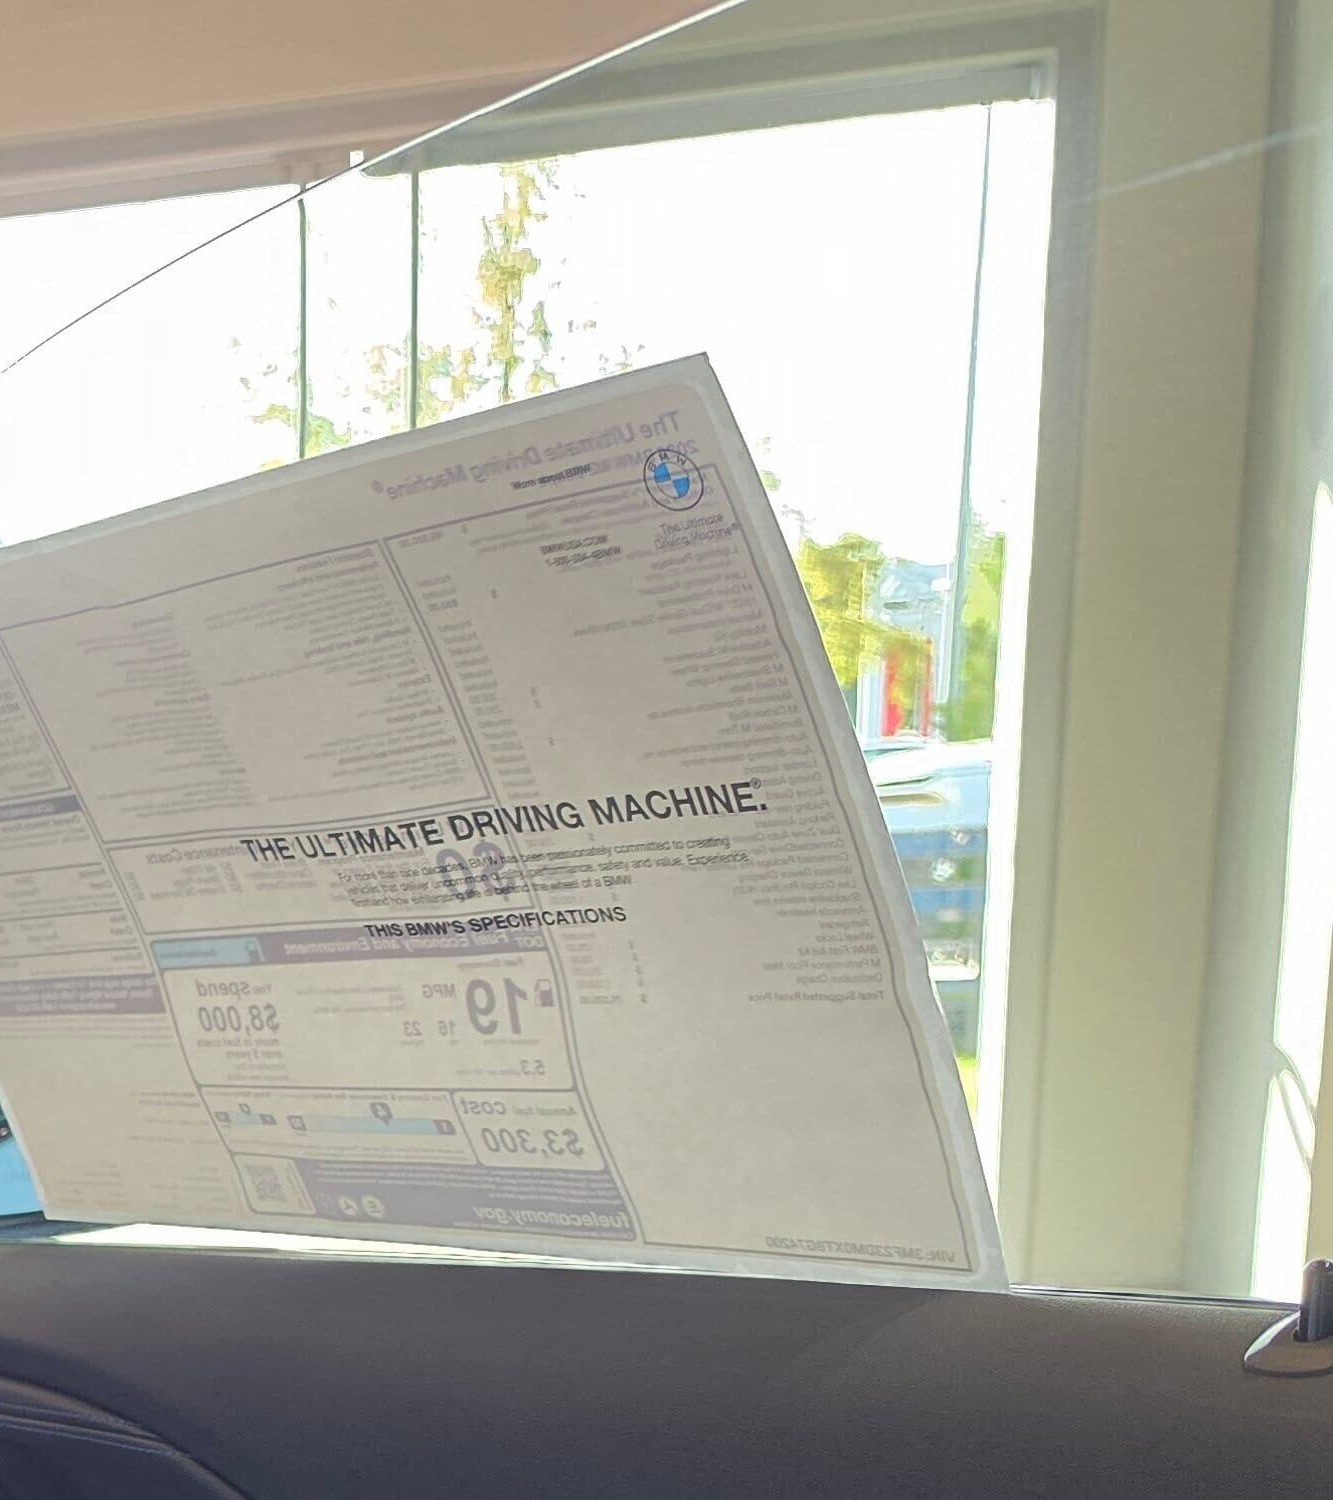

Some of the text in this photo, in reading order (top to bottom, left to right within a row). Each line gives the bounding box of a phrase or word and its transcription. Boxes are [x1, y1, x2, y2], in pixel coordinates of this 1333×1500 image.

[240, 837, 295, 862] THE
[295, 819, 444, 859] ULTIMATE
[447, 802, 585, 841] DRIVING
[613, 841, 671, 855] committed
[671, 839, 685, 850] to
[685, 836, 732, 851] creating
[631, 858, 652, 869] and
[686, 852, 750, 866] Experience
[364, 905, 627, 939] THIS BMW'S SPECIFICATIONS
